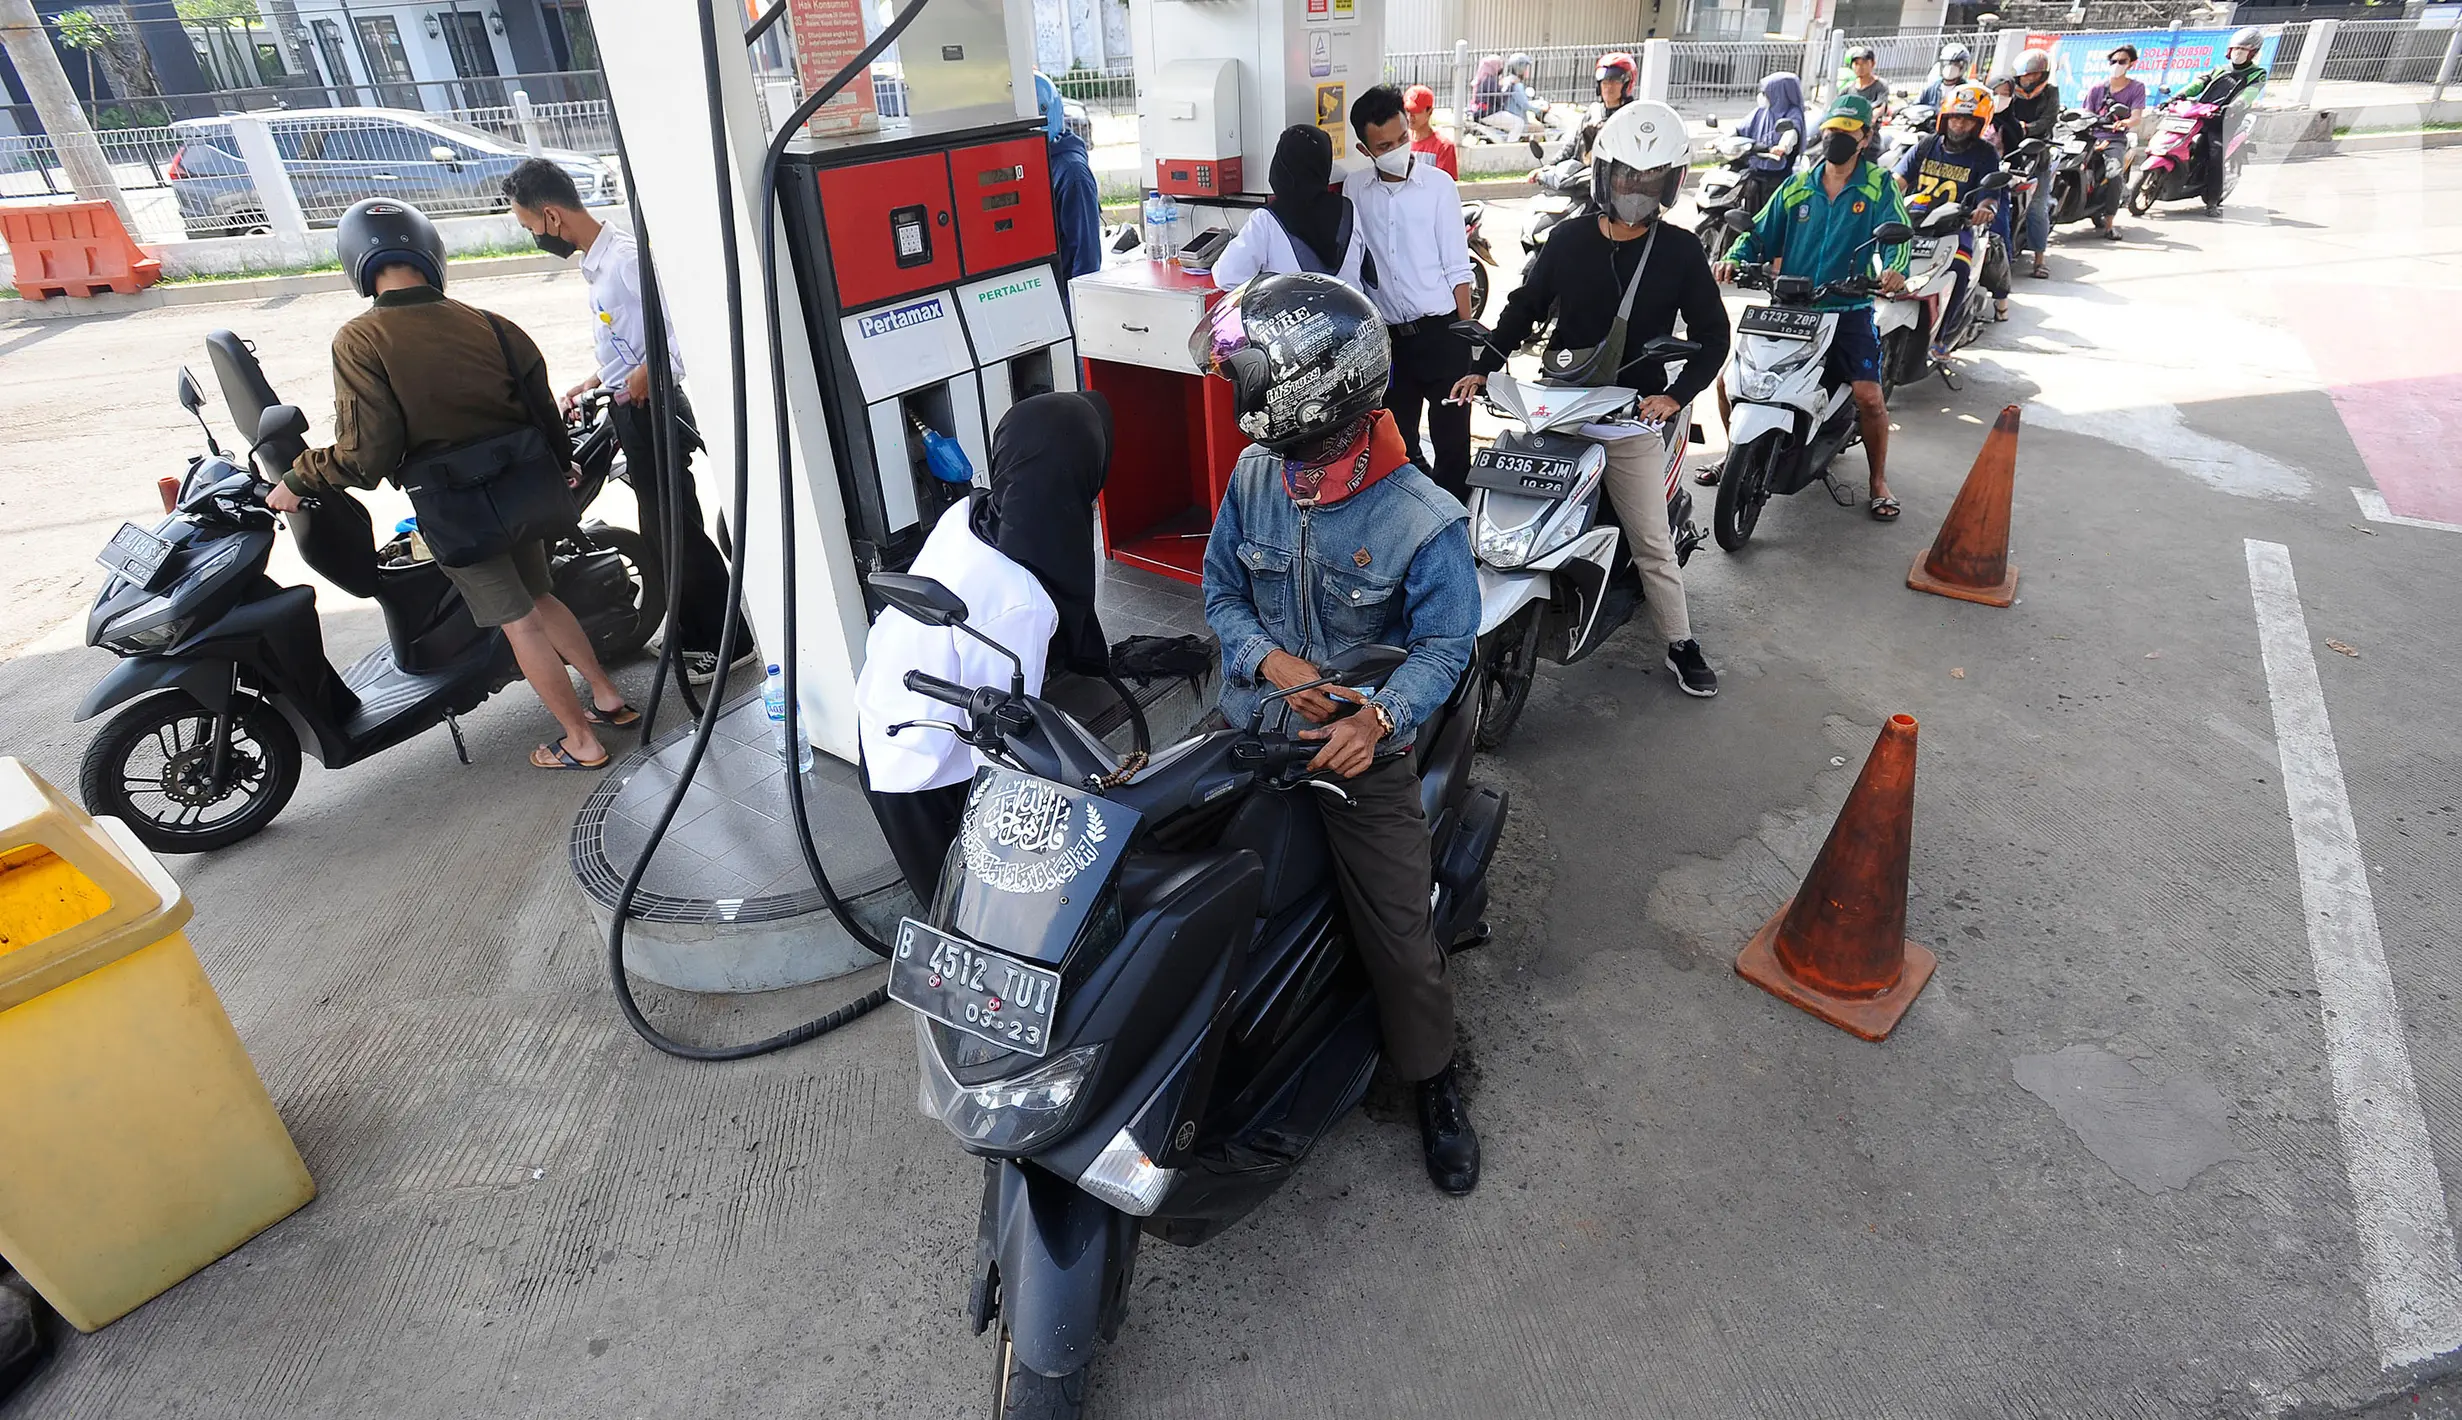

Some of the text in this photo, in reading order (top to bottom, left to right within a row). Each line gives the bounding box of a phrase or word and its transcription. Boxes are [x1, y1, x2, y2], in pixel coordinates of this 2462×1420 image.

[2143, 46, 2175, 59] SOLAR
[2176, 45, 2214, 57] SUBSIDI
[2170, 57, 2200, 69] RODA
[2203, 57, 2211, 68] 4
[978, 277, 1042, 303] PERTALITE
[862, 302, 942, 338] Pertamax
[1747, 308, 1755, 320] B
[1760, 310, 1790, 324] 6732
[1479, 453, 1571, 478] B 6336 ZJM
[116, 528, 130, 544] B
[898, 926, 1050, 1016] B 4512 TUI
